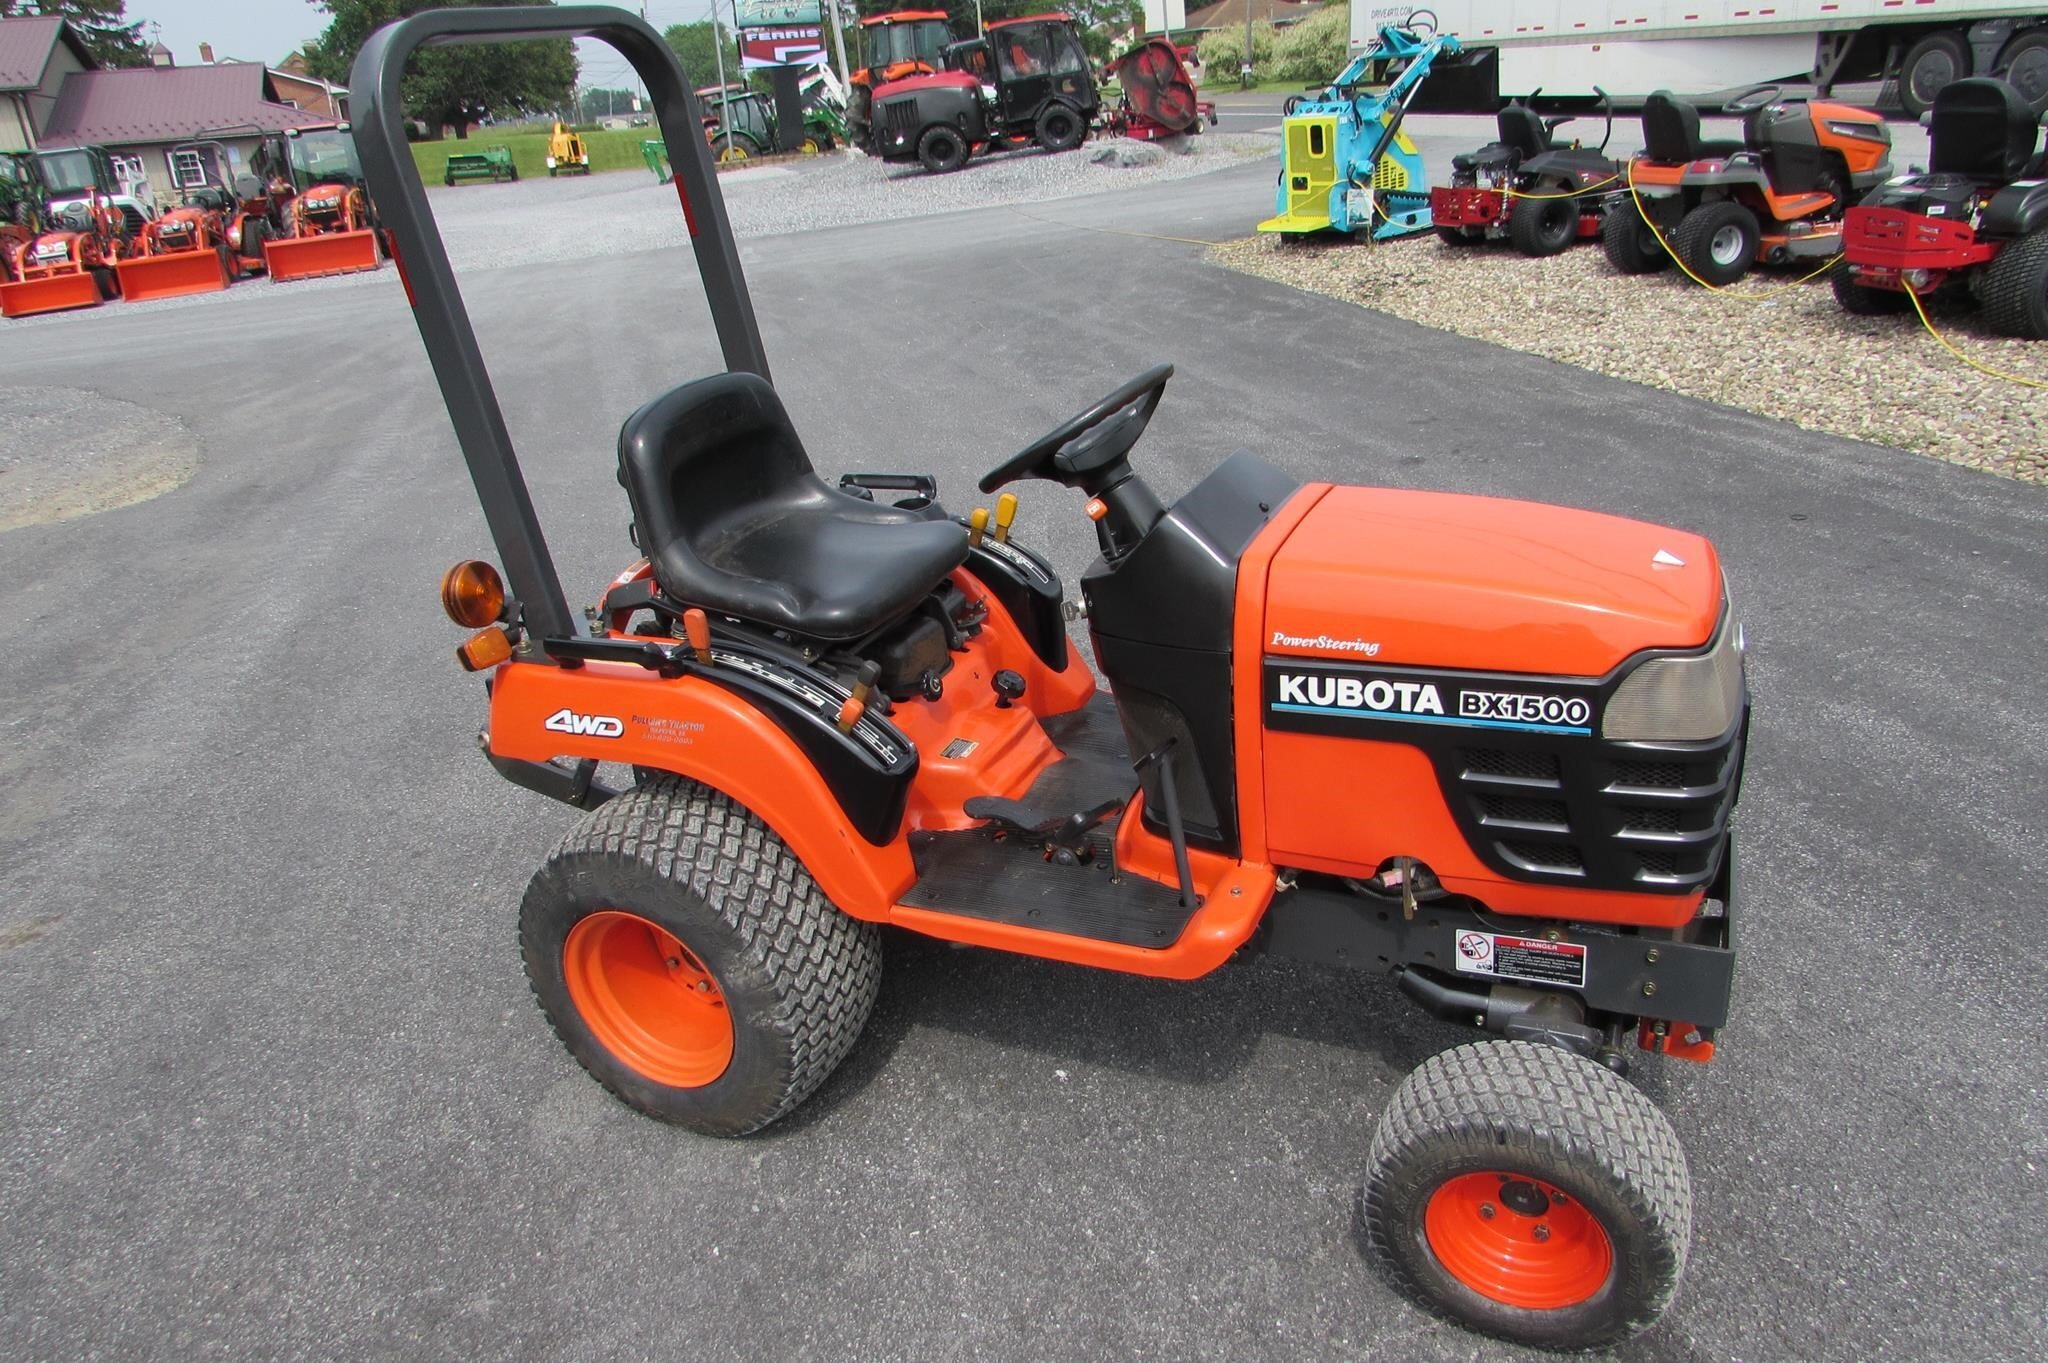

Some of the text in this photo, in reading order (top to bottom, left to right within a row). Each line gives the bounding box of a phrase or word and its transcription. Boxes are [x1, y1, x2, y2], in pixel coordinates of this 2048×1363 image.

[745, 28, 820, 42] FERRIS
[1271, 632, 1381, 656] PowerSteering
[1278, 674, 1445, 714] KUBOTA
[1459, 690, 1592, 725] BX1500
[544, 707, 625, 739] 4WD
[1525, 941, 1558, 952] DANGER
